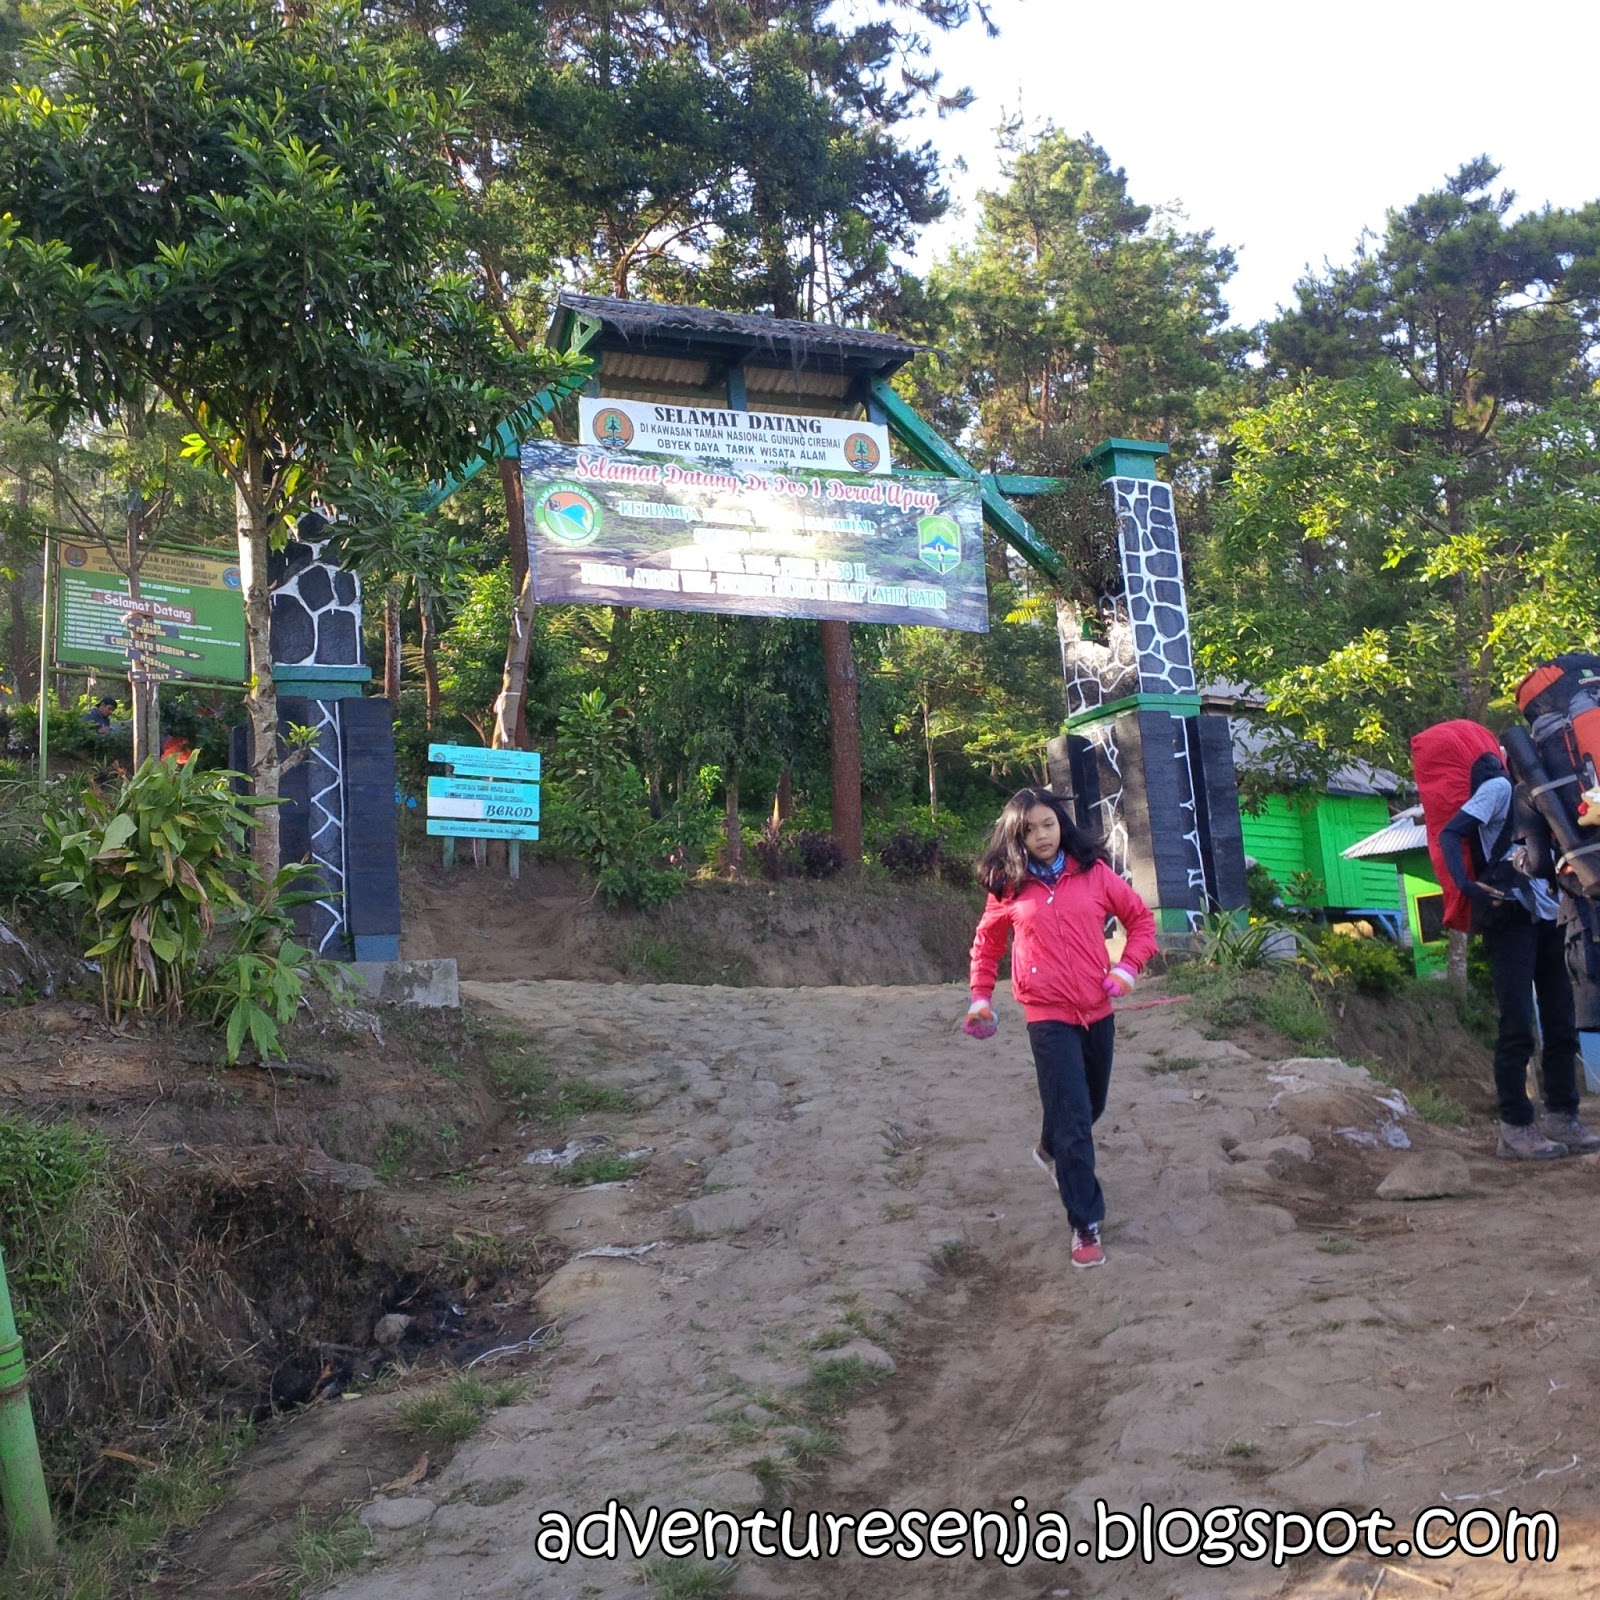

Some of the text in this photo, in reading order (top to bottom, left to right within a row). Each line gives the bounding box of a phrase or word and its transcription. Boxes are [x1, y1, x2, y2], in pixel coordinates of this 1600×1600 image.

[654, 406, 822, 434] SELAMAT DATANG
[640, 423, 841, 449] DI KAWASAN TAMAN NASIONAL GUNUNG CIREMAI
[657, 438, 827, 461] OBYEK DAYA TARIK WISATA ALAM
[576, 453, 659, 483] Selamat
[664, 465, 740, 493] Datang
[744, 473, 770, 492] Di
[774, 476, 806, 496] Pos
[827, 481, 883, 502] Berod
[886, 484, 939, 514] Apuy
[104, 594, 151, 613] Selamat
[153, 601, 192, 622] Datang
[868, 586, 907, 606] LAHIR
[908, 588, 947, 609] BATIN
